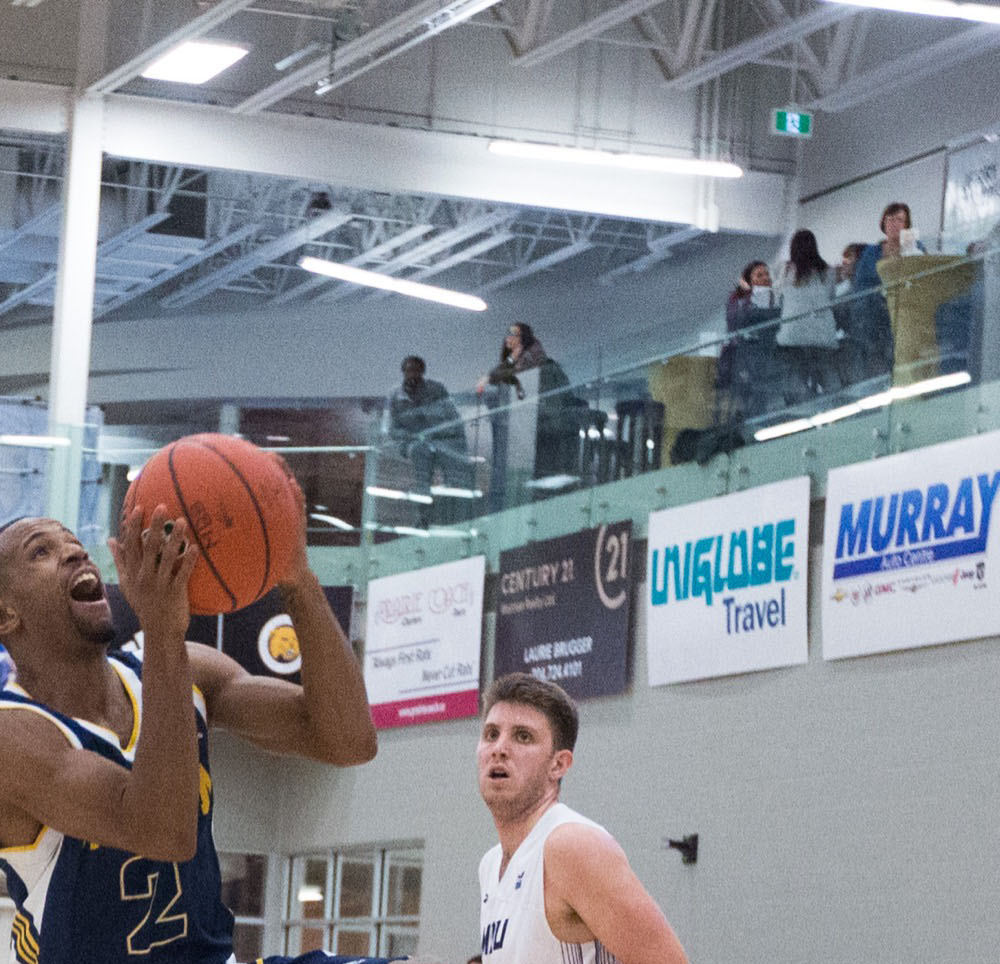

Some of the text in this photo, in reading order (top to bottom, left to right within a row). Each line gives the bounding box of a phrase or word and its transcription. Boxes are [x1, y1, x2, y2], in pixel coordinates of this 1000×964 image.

[835, 469, 1000, 560] MURRAY
[501, 557, 575, 596] CENTURY 21
[723, 587, 787, 635] Travel
[120, 853, 187, 954] 2
